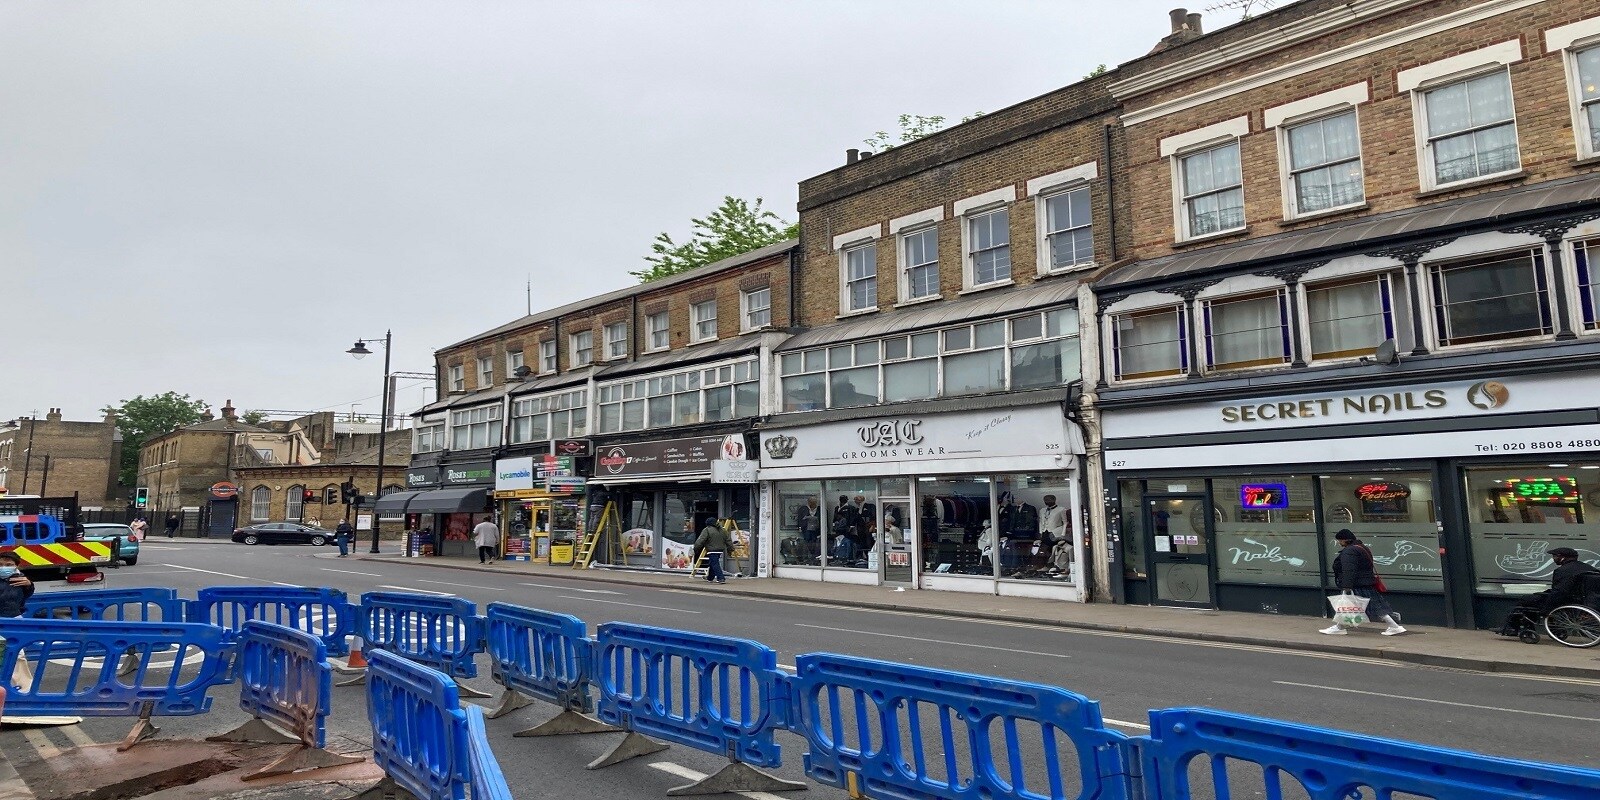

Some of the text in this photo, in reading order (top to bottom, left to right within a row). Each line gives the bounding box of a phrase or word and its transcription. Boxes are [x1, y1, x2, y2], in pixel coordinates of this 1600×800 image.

[1221, 389, 1447, 423] SECRET NAILS
[1475, 439, 1600, 452] Tel: 020 8808 4880
[842, 446, 946, 459] GROOMS WEAR
[500, 469, 530, 480] Lycamobile
[1518, 483, 1564, 496] SPA
